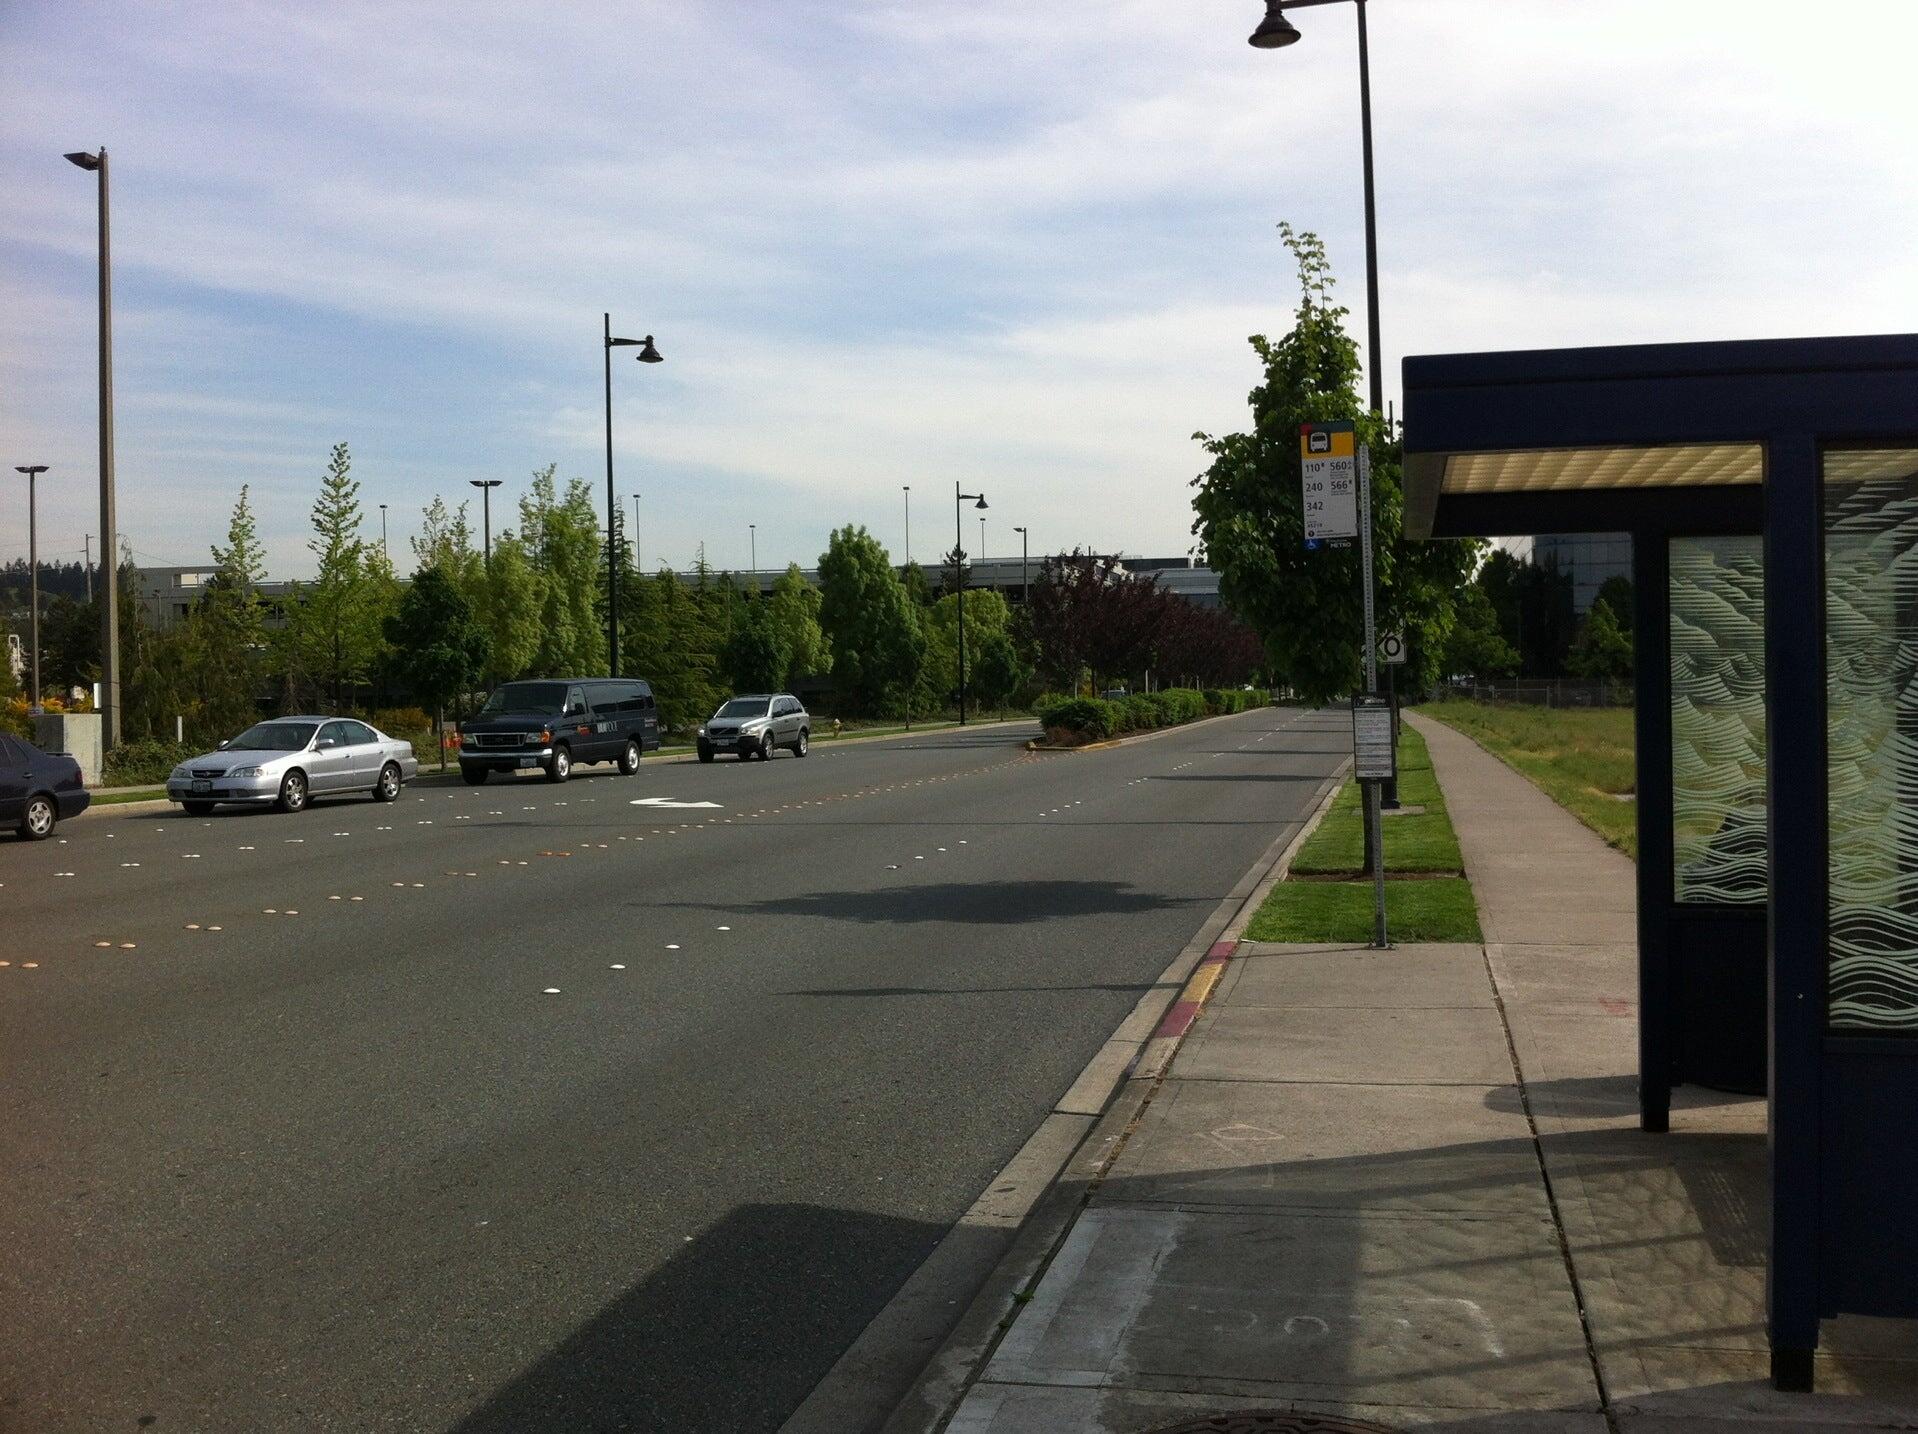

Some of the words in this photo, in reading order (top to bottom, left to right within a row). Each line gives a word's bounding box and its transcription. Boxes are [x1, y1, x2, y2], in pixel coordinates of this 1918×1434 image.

[1305, 463, 1320, 473] 110
[1330, 461, 1346, 471] 560
[1305, 482, 1323, 492] 240
[1330, 480, 1348, 490] 566
[1306, 501, 1324, 511] 342
